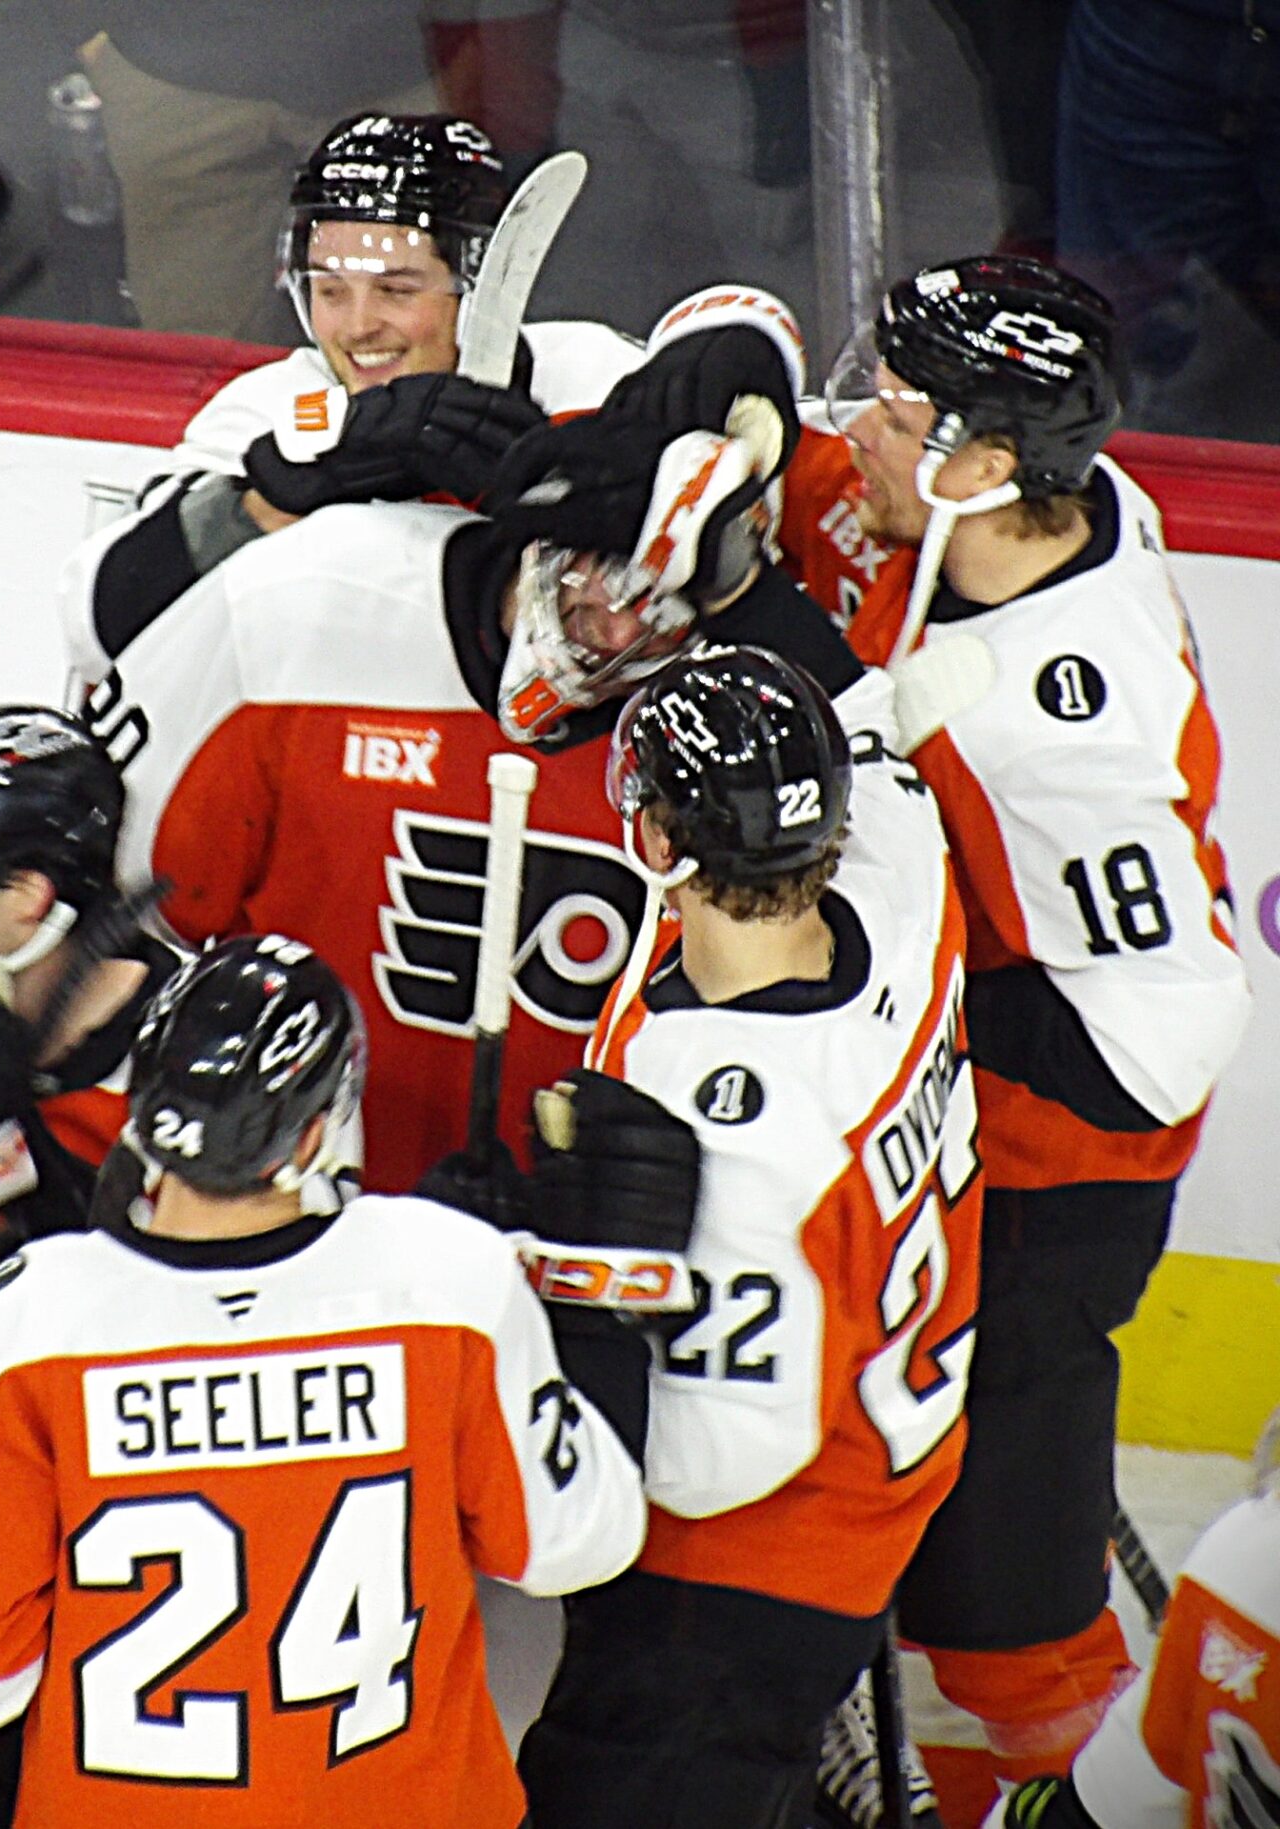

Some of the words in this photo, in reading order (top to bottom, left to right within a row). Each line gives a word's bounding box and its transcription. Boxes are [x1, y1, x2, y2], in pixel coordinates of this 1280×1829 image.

[819, 500, 890, 583] IBX
[1054, 660, 1091, 716] 1
[341, 732, 438, 788] IBX
[778, 777, 822, 828] 22
[1062, 843, 1172, 957] 18
[708, 1070, 745, 1121] 1
[152, 1108, 205, 1158] 24
[113, 1362, 379, 1460] SEELER
[66, 1467, 425, 1789] 24
